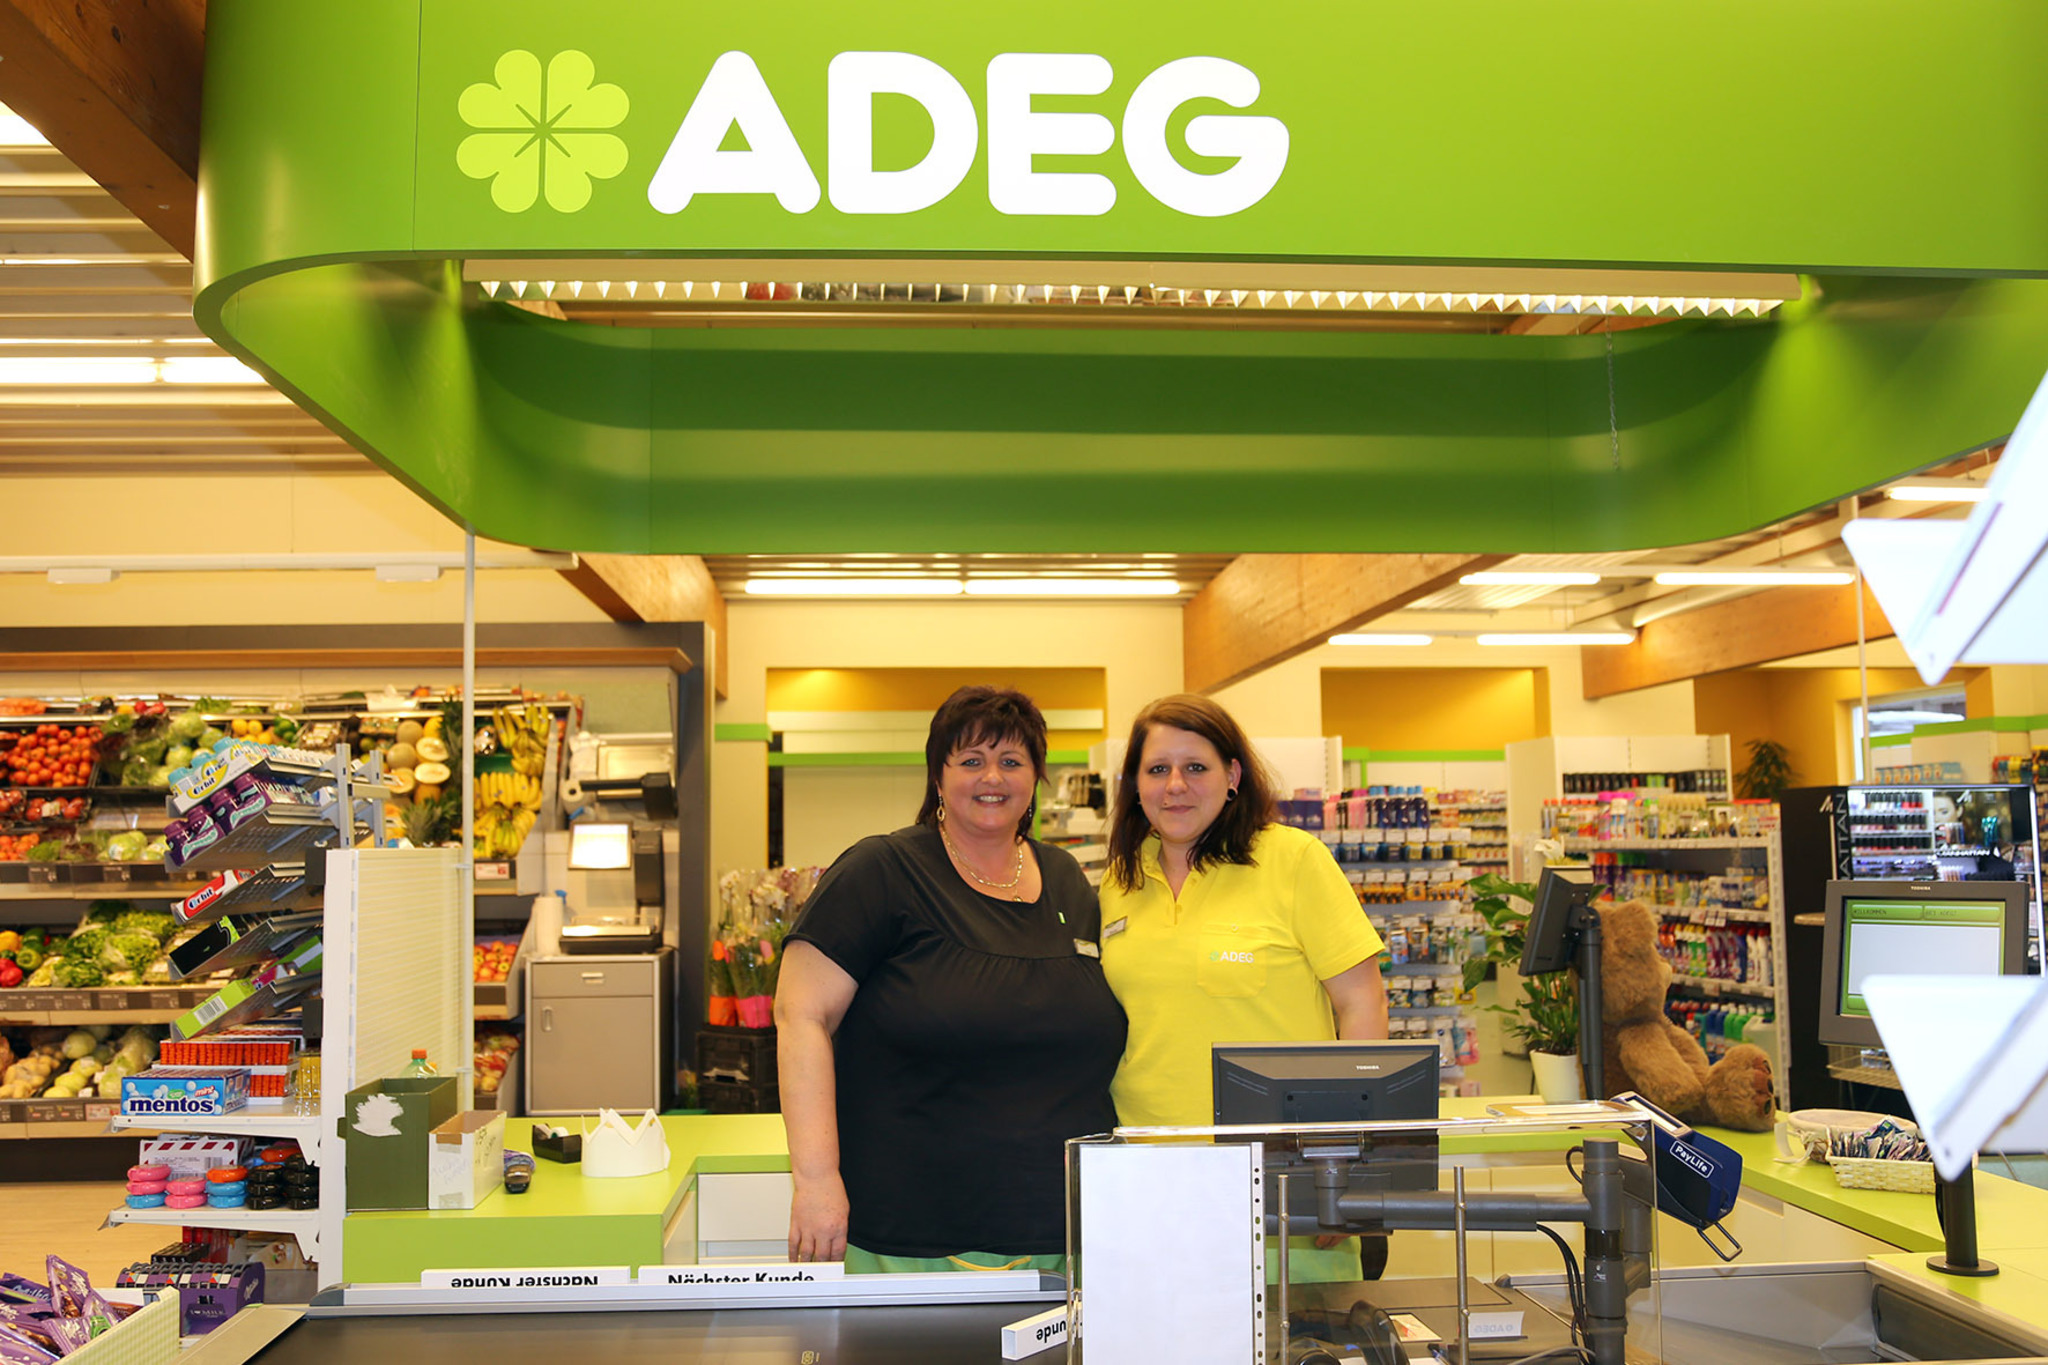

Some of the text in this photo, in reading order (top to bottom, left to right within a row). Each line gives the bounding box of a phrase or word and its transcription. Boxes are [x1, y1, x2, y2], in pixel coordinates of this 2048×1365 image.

[648, 51, 1289, 217] ADEG
[193, 776, 216, 795] Orbit
[188, 888, 214, 909] Orbit
[1220, 950, 1255, 964] ADEG
[129, 1097, 214, 1113] mentos
[1675, 1144, 1708, 1173] PayLife
[1036, 1320, 1067, 1344] unde
